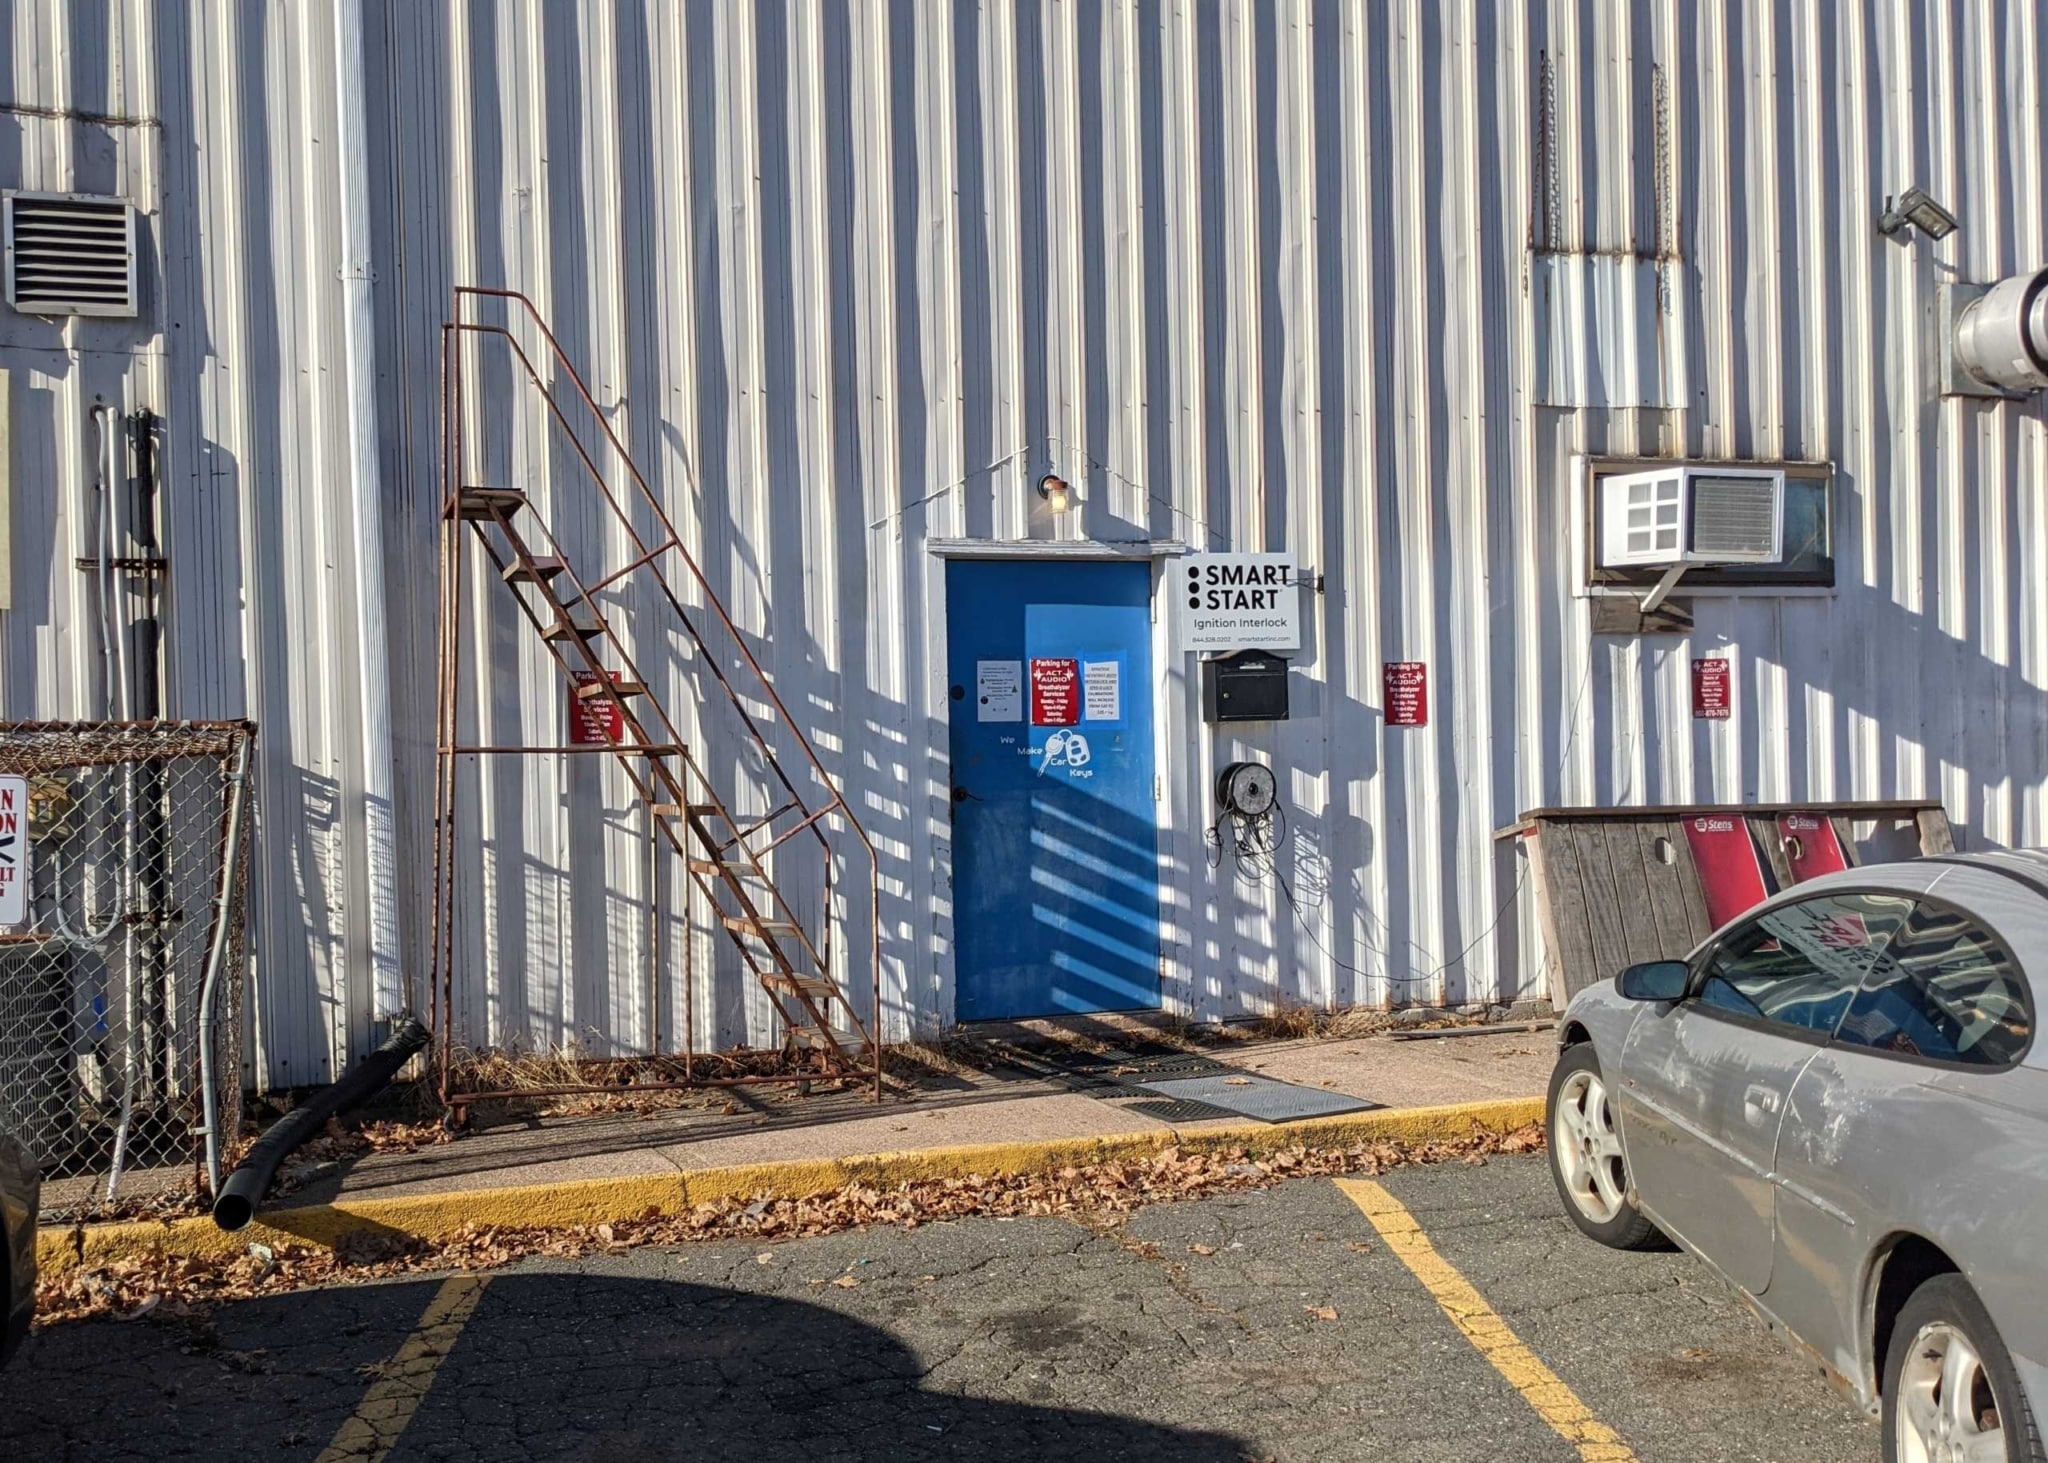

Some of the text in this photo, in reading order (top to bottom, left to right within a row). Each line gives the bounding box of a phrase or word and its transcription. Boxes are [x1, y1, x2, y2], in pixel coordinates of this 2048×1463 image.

[1206, 565, 1290, 585] SMART
[1207, 589, 1278, 610] START
[1194, 618, 1287, 630] Ignition Interlock
[1036, 660, 1060, 668] Parking
[1000, 736, 1015, 744] We
[1017, 746, 1043, 755] Make
[1050, 758, 1068, 766] Car
[1069, 769, 1093, 778] Keys
